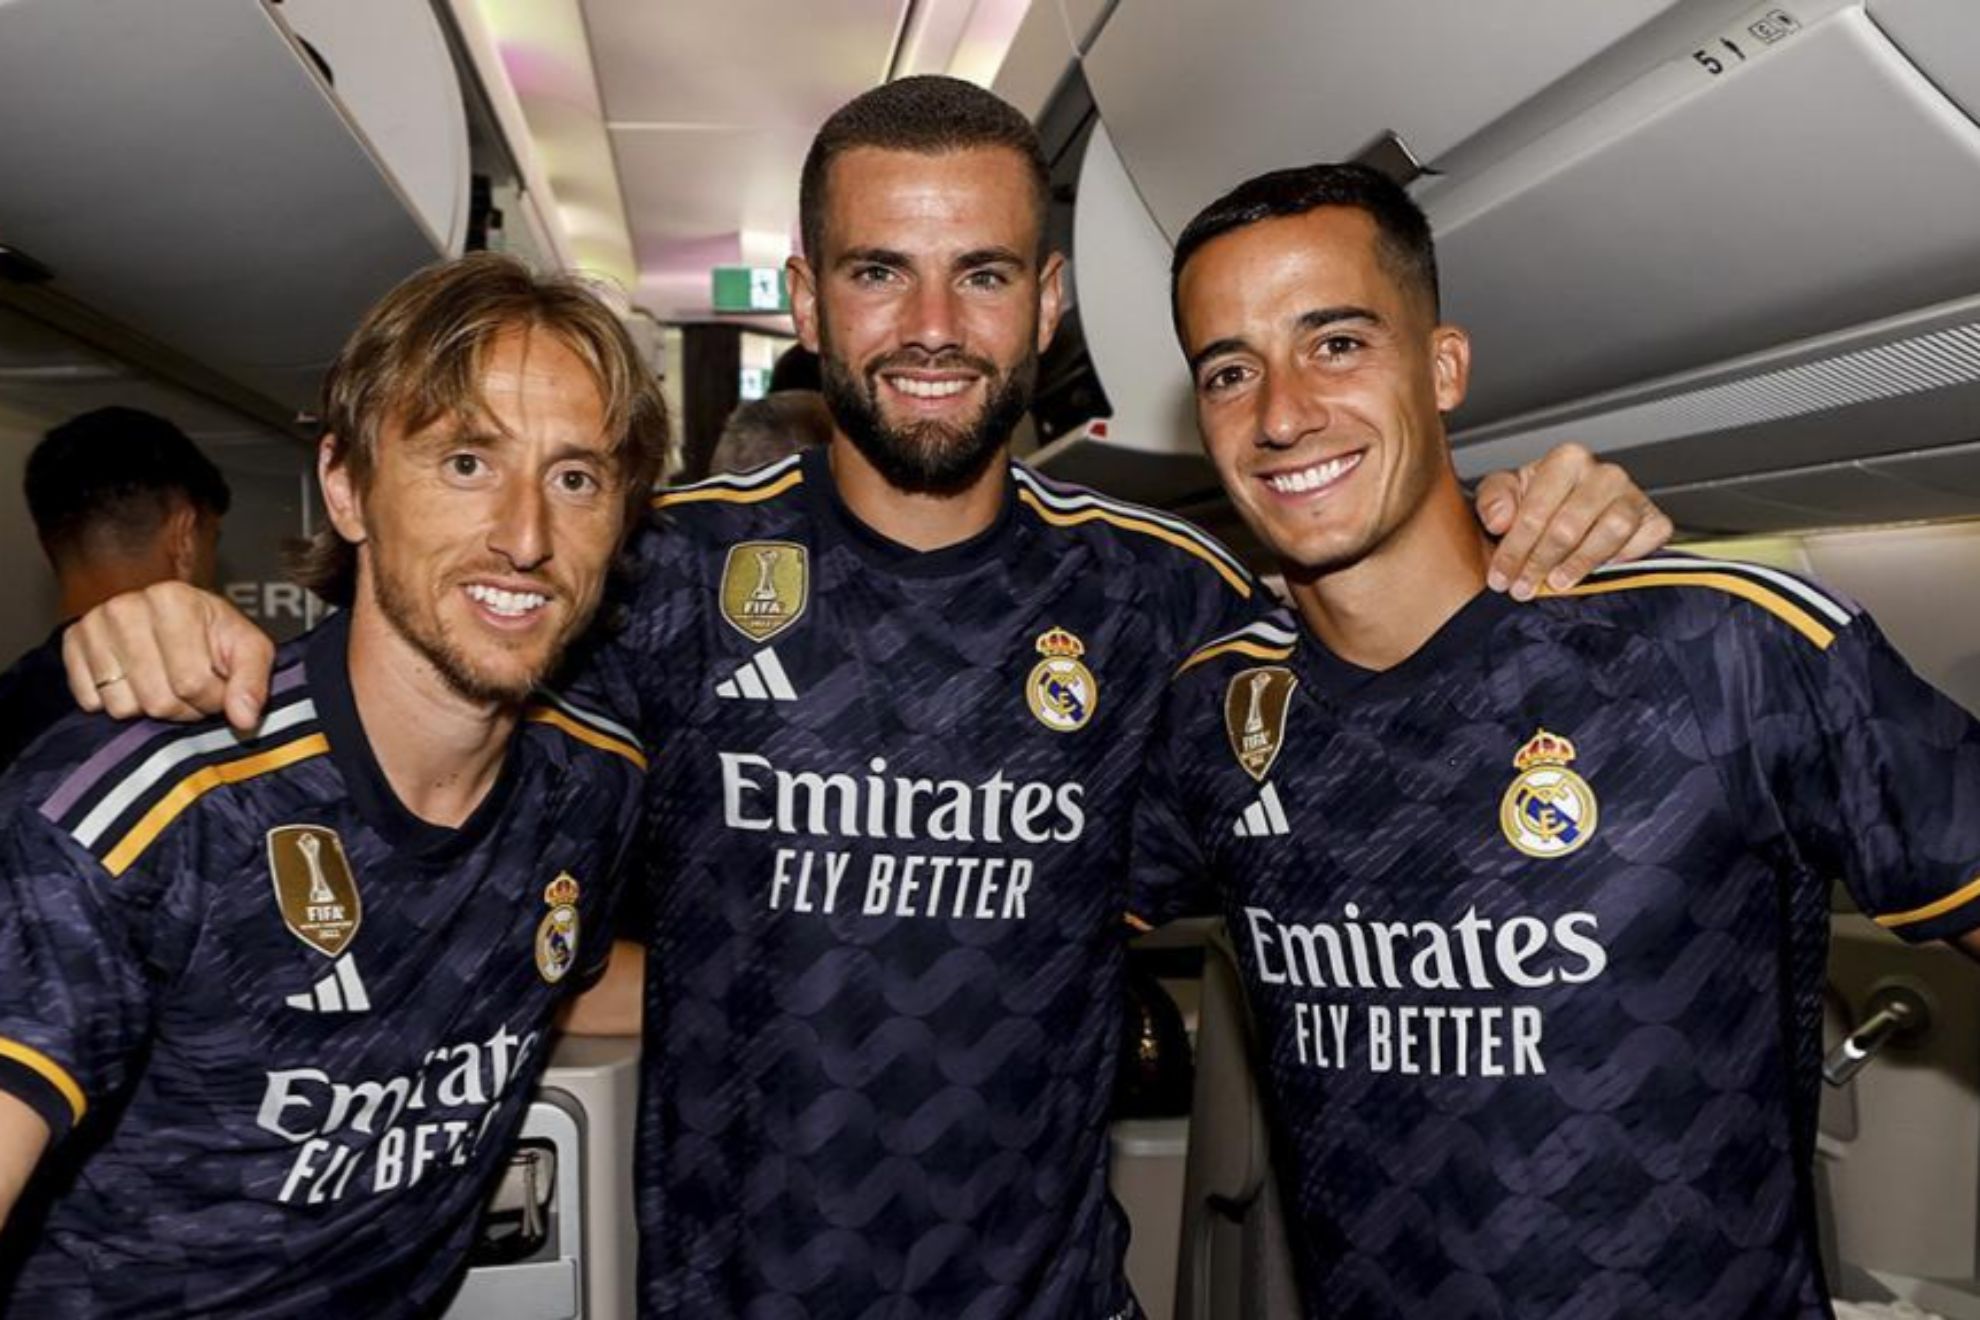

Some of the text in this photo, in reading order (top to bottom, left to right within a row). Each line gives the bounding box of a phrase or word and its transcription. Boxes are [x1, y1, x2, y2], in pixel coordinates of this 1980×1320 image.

[1693, 50, 1723, 75] 5
[743, 601, 780, 614] FIFA
[718, 752, 1085, 843] Emirates
[306, 905, 346, 921] FIFA
[769, 848, 1033, 919] FLY BETTER
[1244, 902, 1607, 990] Emirates
[1295, 1002, 1546, 1077] FLY BETTER
